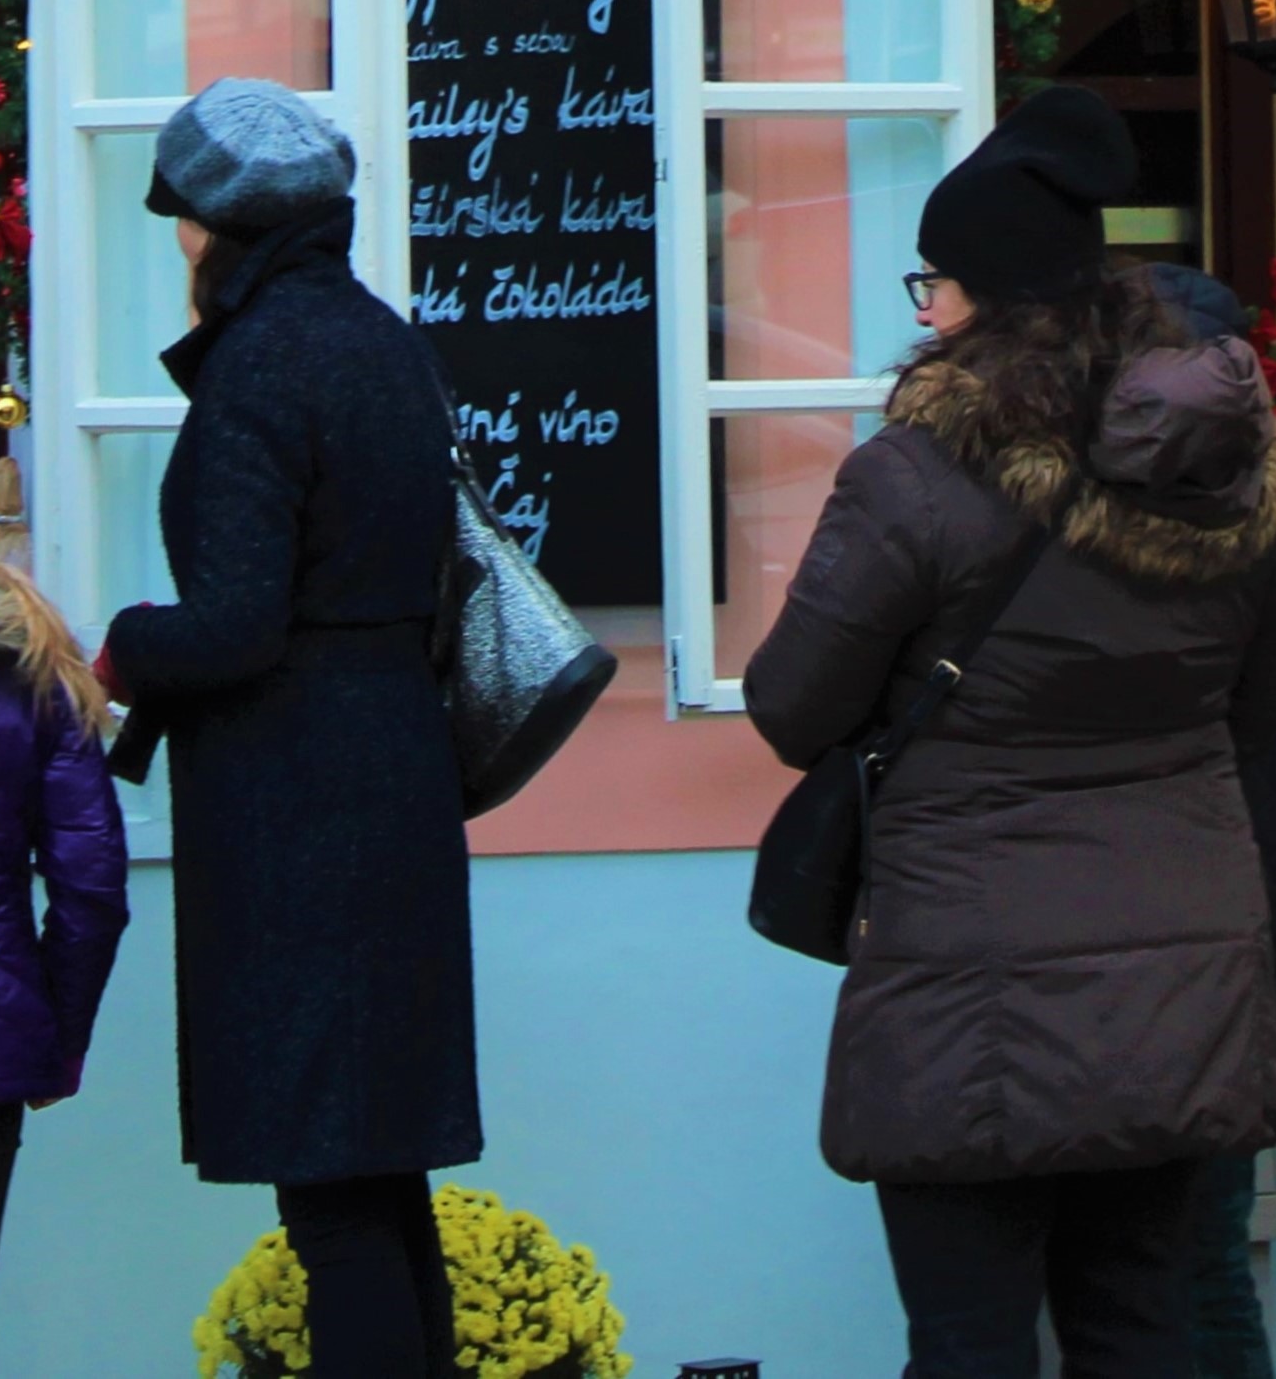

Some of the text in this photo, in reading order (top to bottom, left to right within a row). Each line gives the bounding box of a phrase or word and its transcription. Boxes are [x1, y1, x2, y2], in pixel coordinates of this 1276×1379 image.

[484, 36, 499, 56] s
[408, 65, 655, 181] ailey's káva
[410, 172, 656, 237] žírská káva
[484, 262, 651, 321] čokoláda
[539, 390, 620, 445] víno
[487, 453, 552, 565] Čaj
